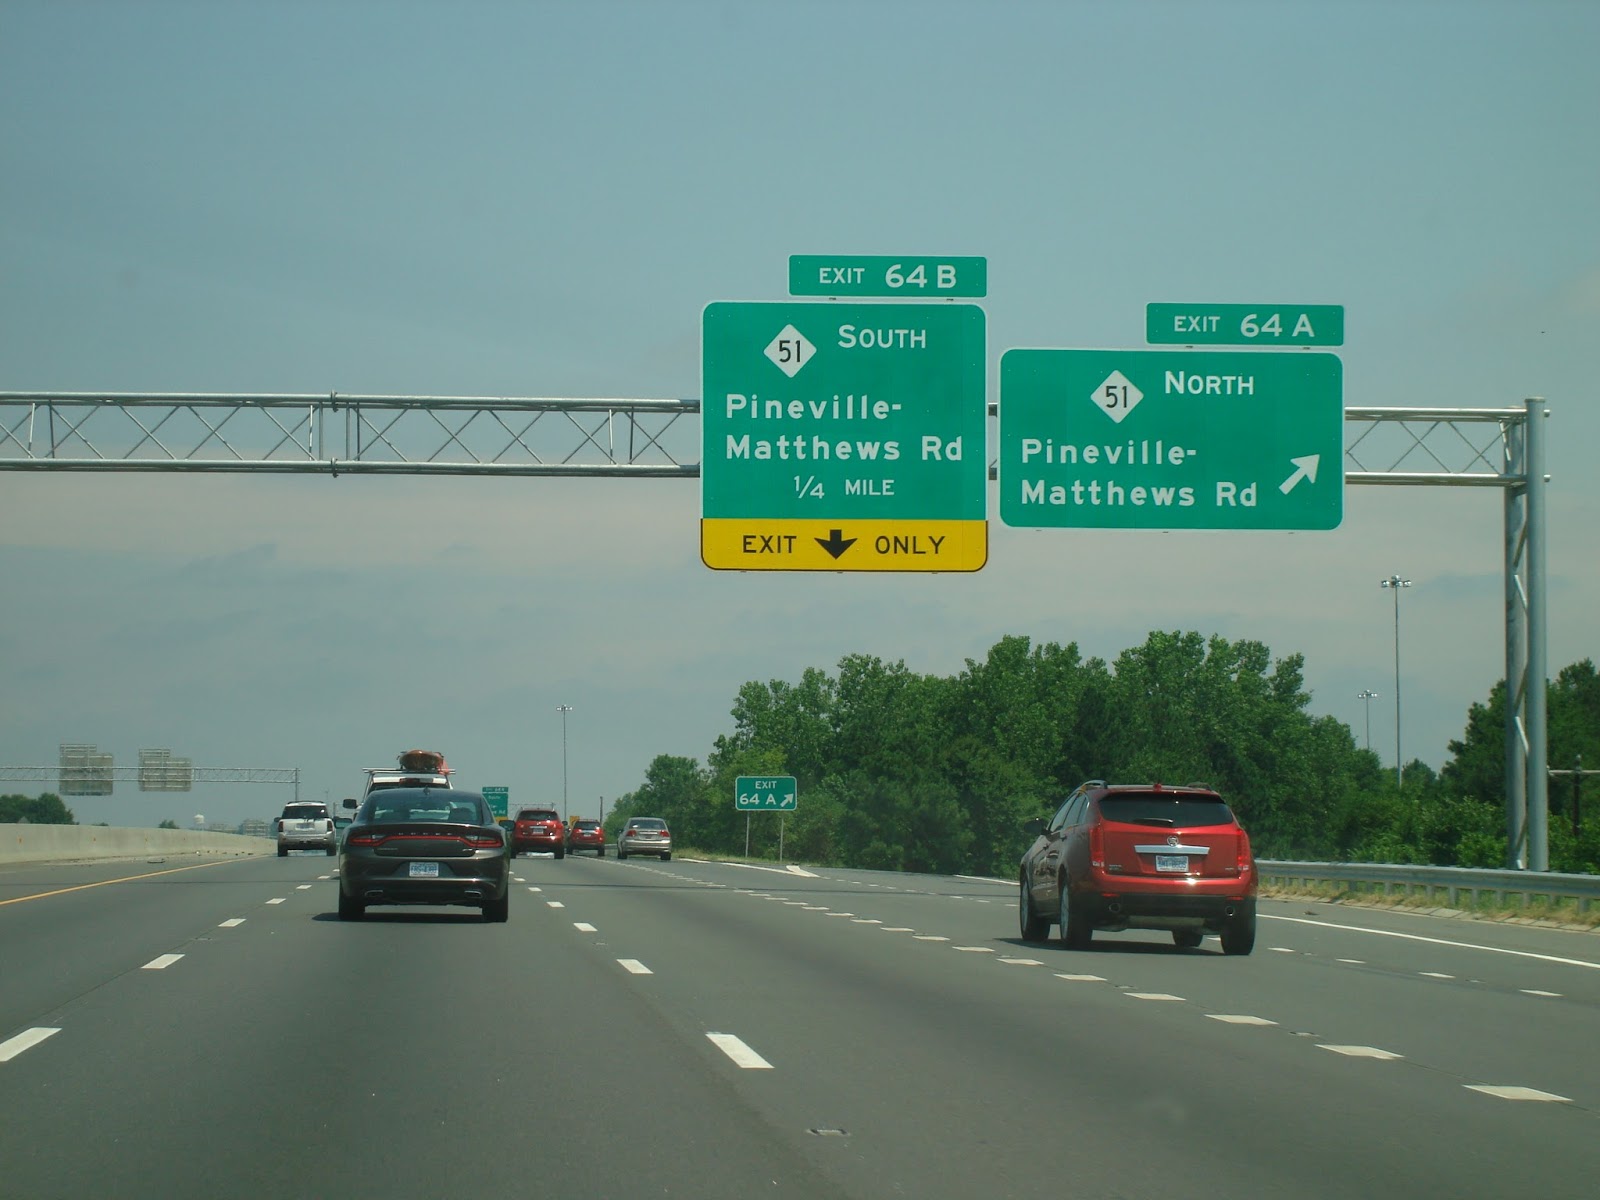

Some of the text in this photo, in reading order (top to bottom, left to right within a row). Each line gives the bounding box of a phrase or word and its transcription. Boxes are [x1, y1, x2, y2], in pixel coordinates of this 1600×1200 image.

[819, 264, 956, 288] EXIT 64 B
[1174, 313, 1315, 338] EXIT 64 A
[779, 324, 926, 362] 51 SOUTH
[1105, 371, 1254, 408] 51 NORTH
[726, 394, 902, 420] Pineville-
[726, 435, 962, 461] Matthews Rd
[1021, 439, 1196, 465] Pineville-
[845, 479, 895, 496] MILE
[1021, 480, 1257, 507] Matthews Rd
[743, 535, 945, 554] EXIT ONLY
[755, 781, 777, 789] EXIT
[739, 793, 776, 805] 64 A
